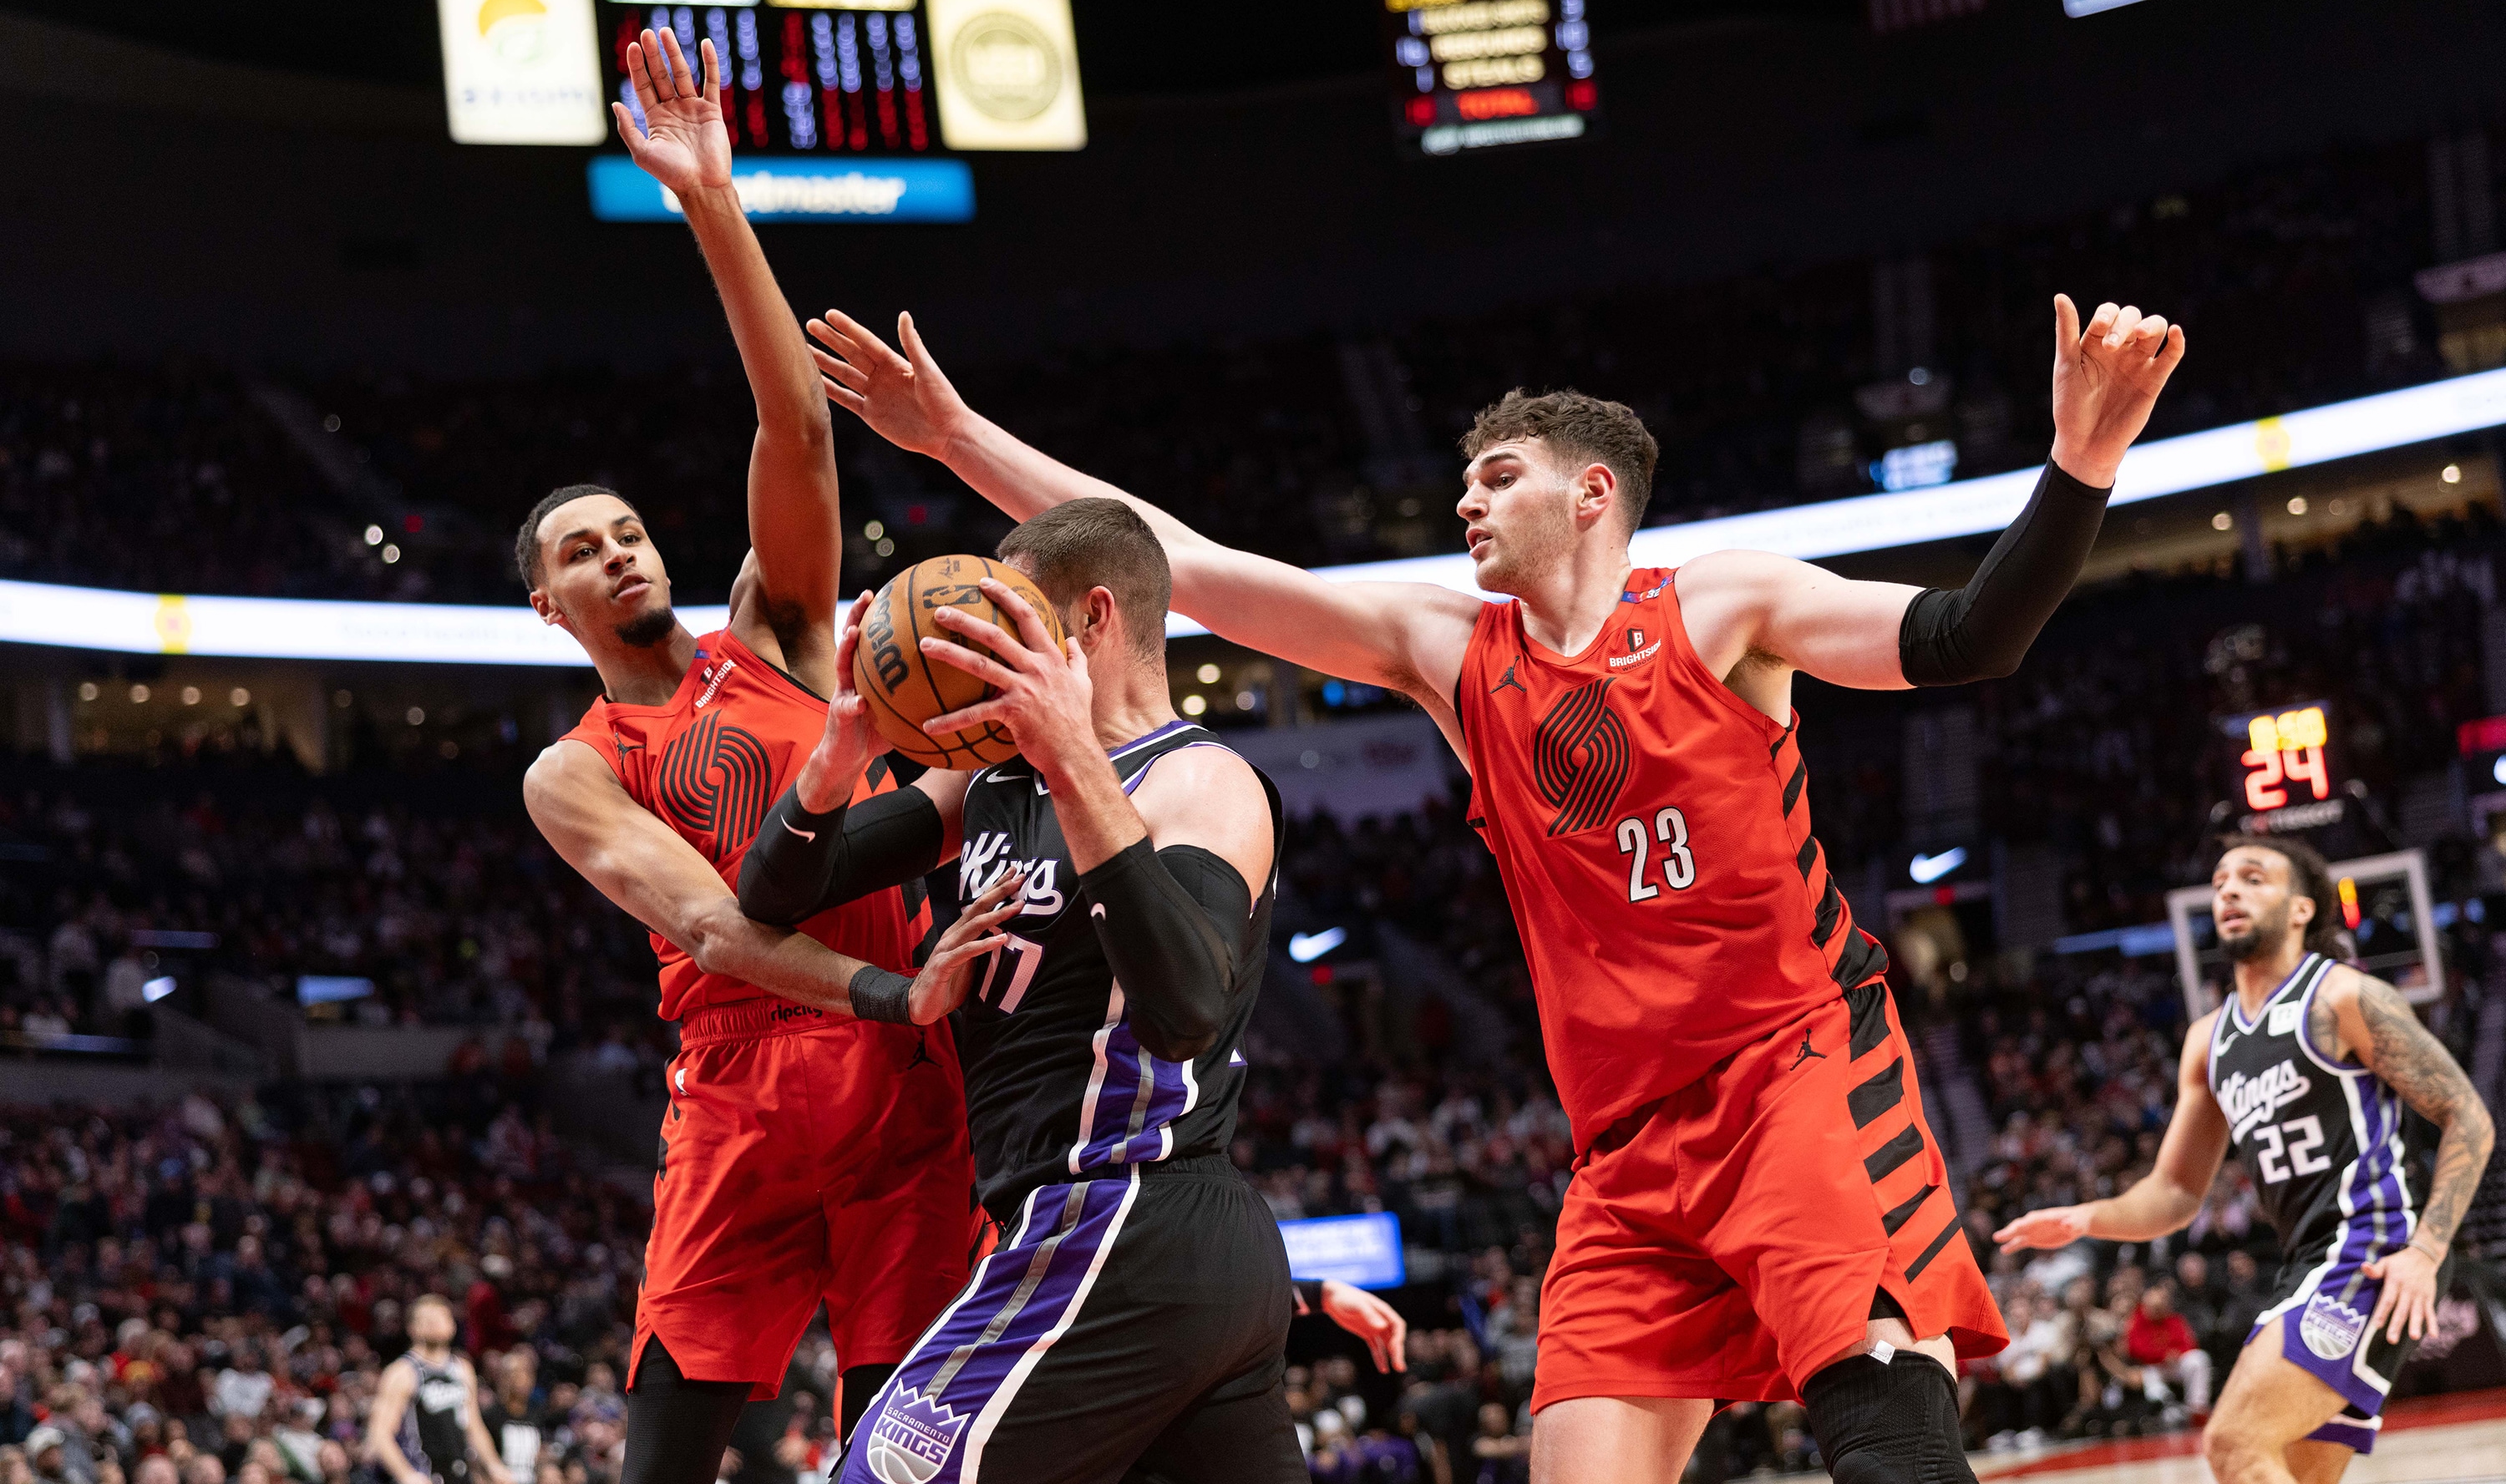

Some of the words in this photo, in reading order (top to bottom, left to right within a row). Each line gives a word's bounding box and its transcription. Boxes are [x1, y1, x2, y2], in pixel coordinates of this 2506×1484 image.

[695, 659, 737, 708] BRIGHTSIDE
[2240, 745, 2330, 812] 24
[1616, 806, 1696, 904] 23
[2216, 1058, 2311, 1145] Kings
[2253, 1115, 2331, 1184] 22
[875, 1416, 947, 1466] KINGS
[887, 1406, 950, 1444] SACRAMENTO
